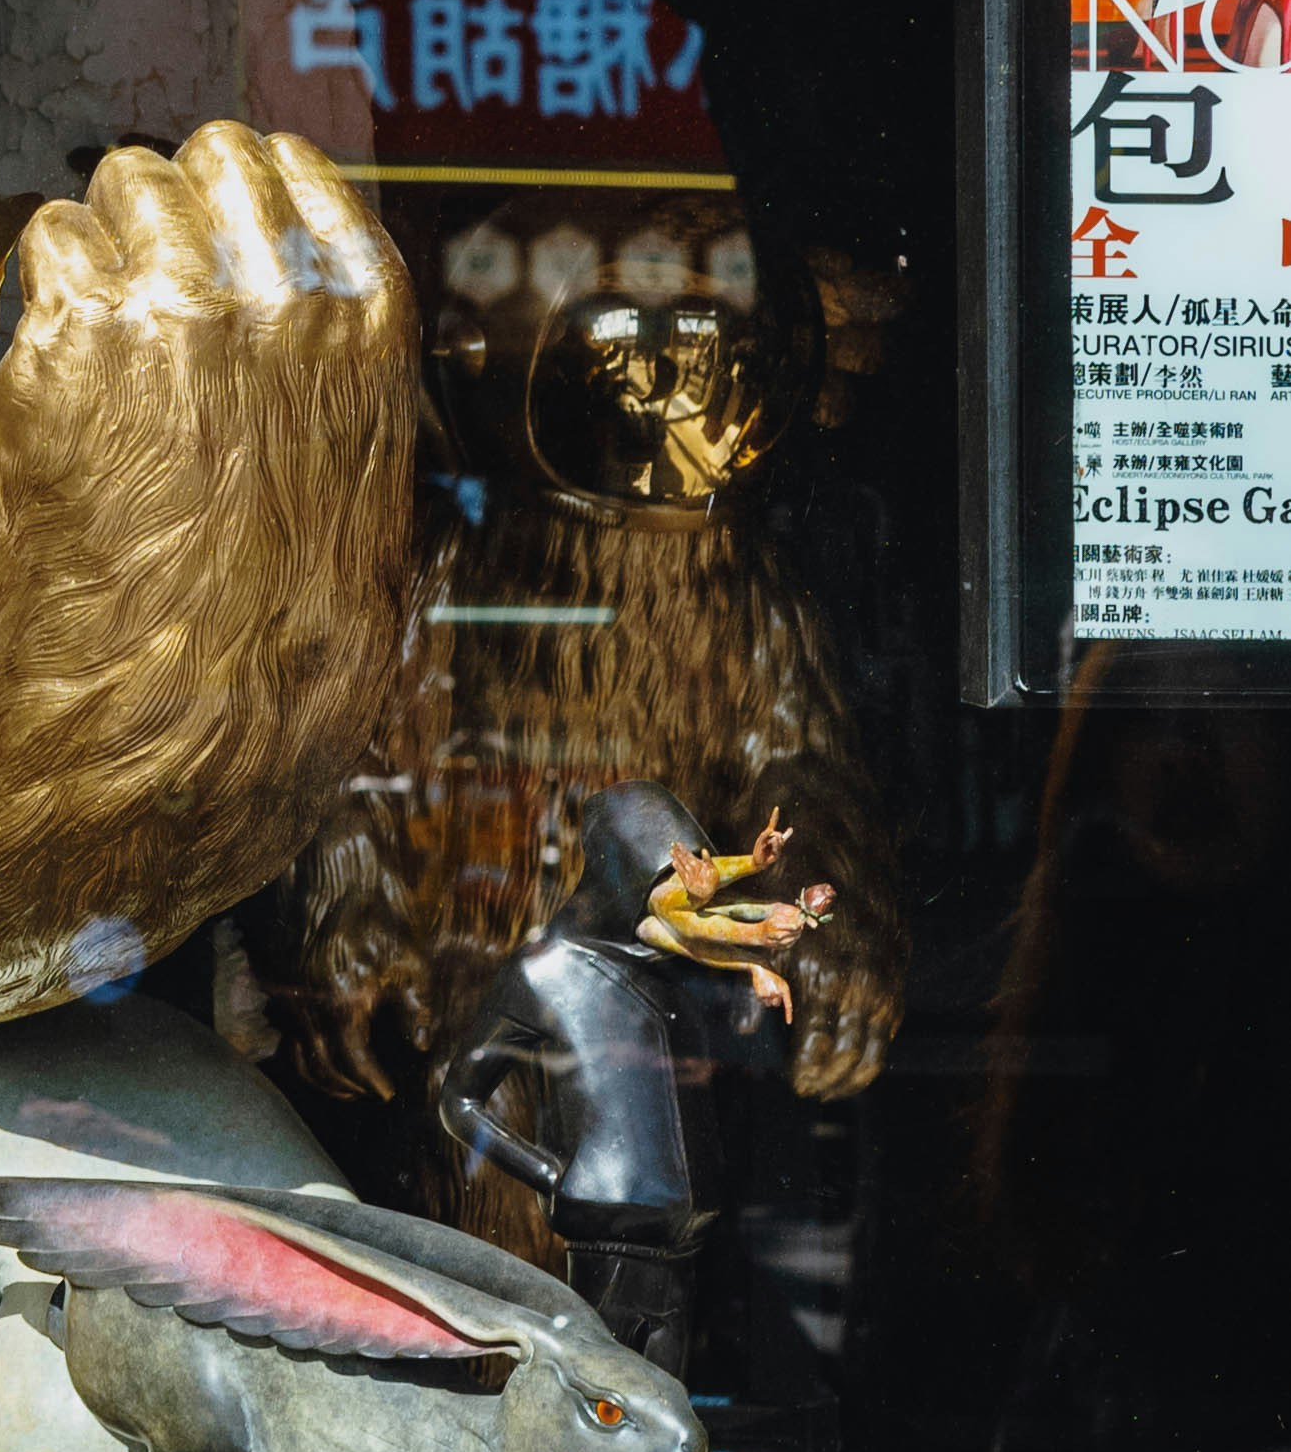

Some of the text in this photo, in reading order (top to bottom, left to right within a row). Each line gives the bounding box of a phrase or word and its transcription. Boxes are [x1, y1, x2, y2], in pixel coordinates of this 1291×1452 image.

[1071, 71, 1235, 204] 包
[1074, 389, 1132, 400] ECUTIVE
[1230, 390, 1256, 400] RAN
[1073, 485, 1230, 531] Eclipse
